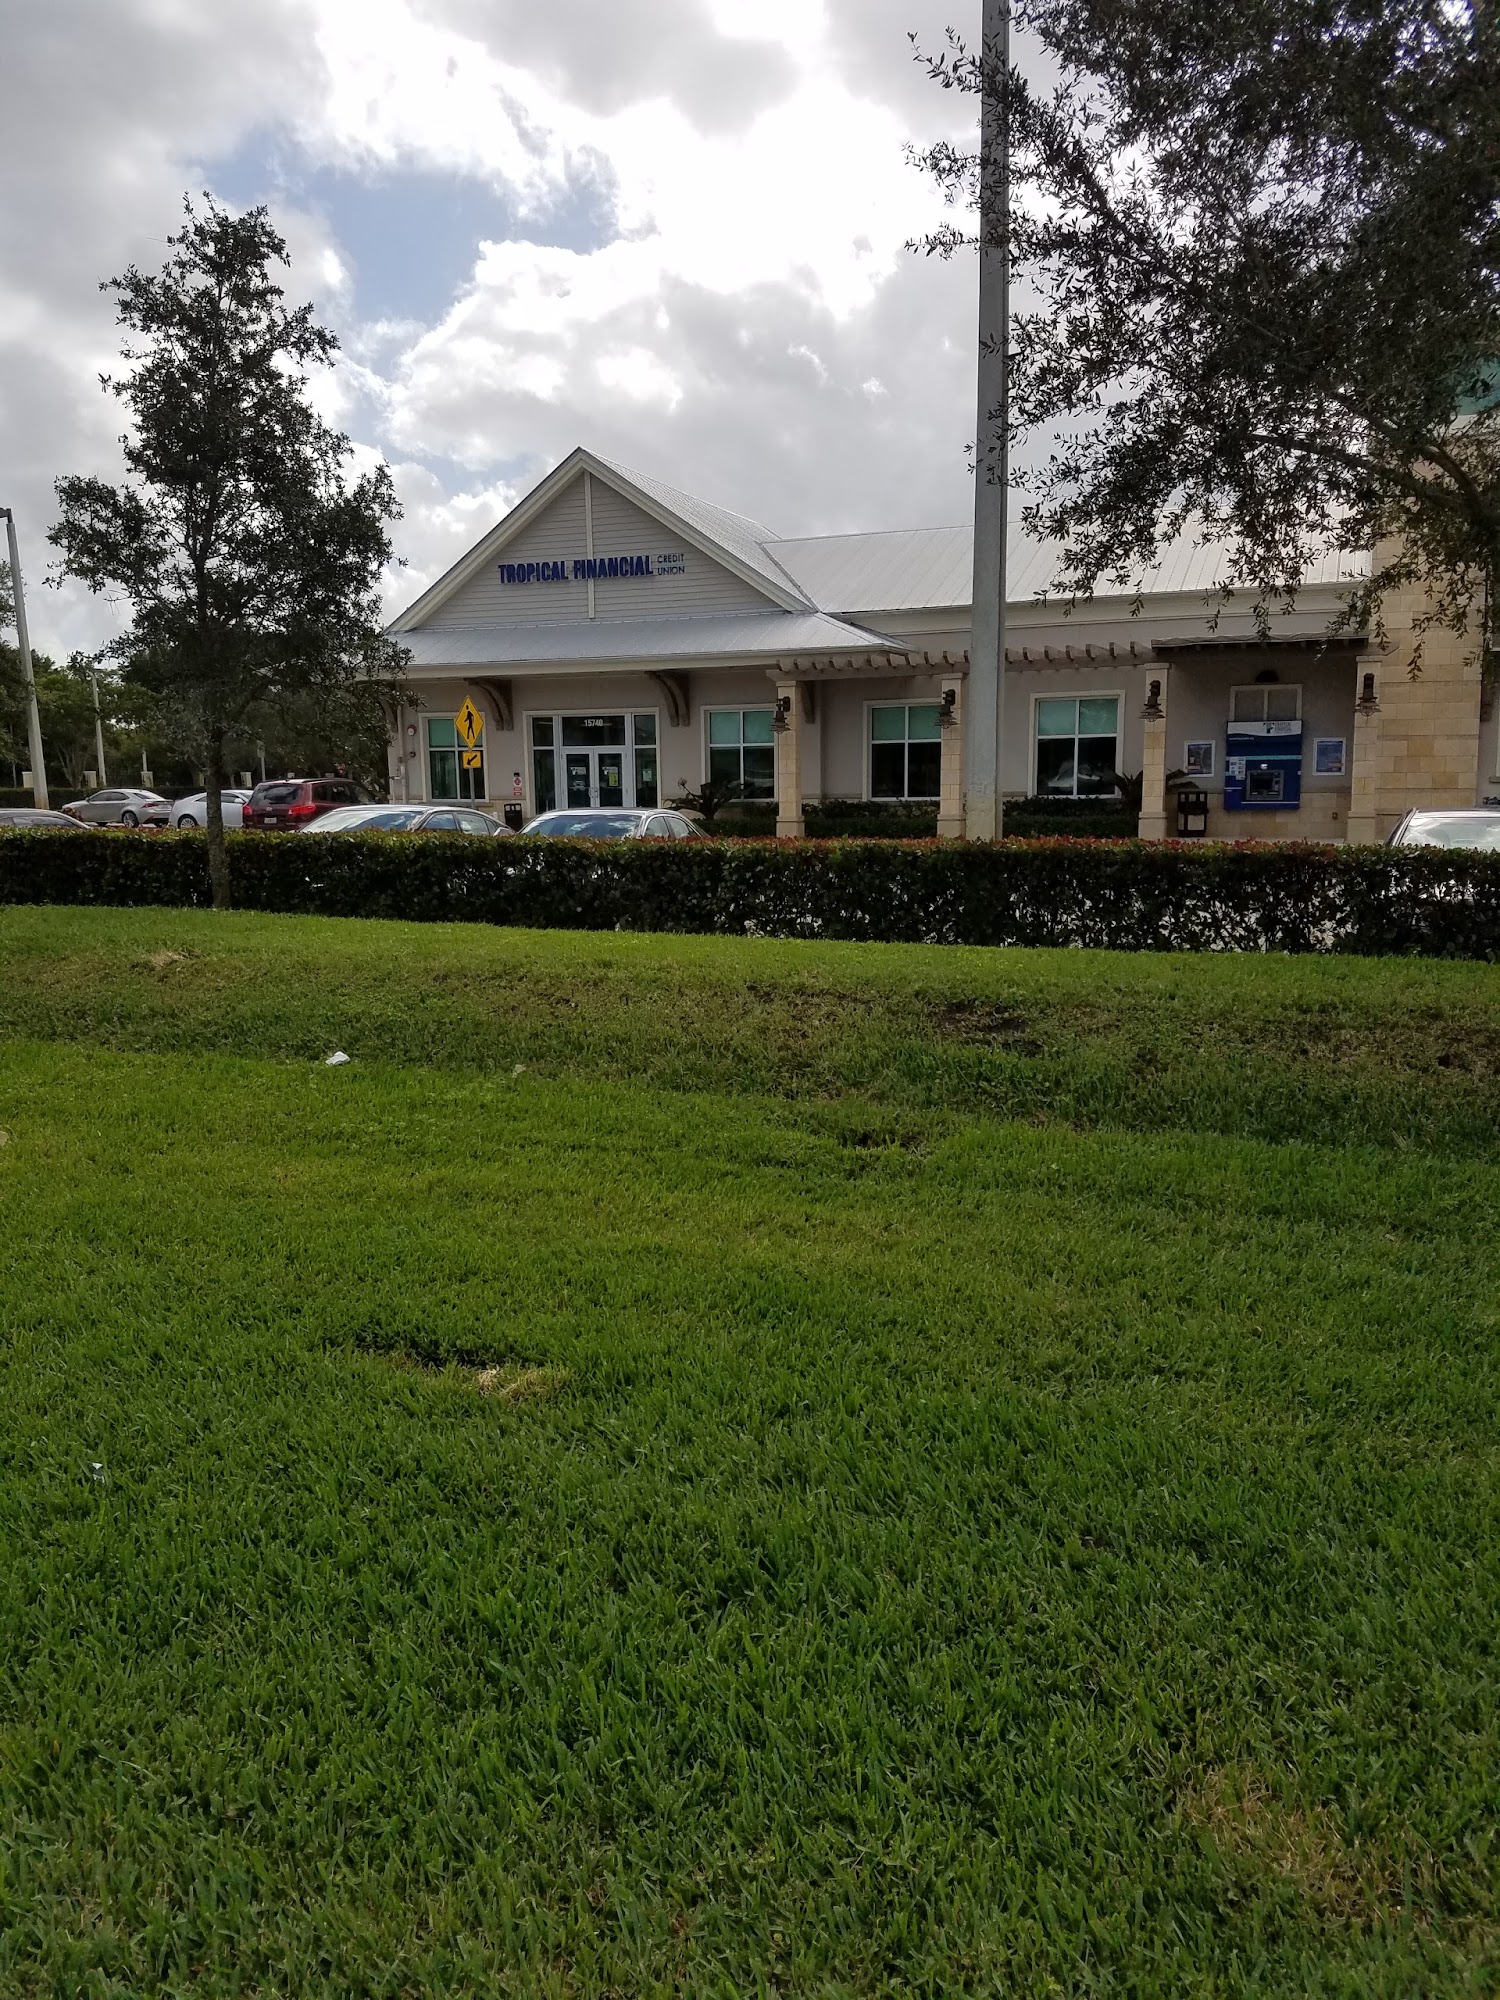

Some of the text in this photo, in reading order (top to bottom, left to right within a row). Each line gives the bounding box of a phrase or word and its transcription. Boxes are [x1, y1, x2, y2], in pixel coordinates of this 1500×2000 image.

[657, 554, 684, 564] CREDIT
[498, 556, 653, 584] TROPICAL FINANCIAL
[657, 566, 685, 575] UNION
